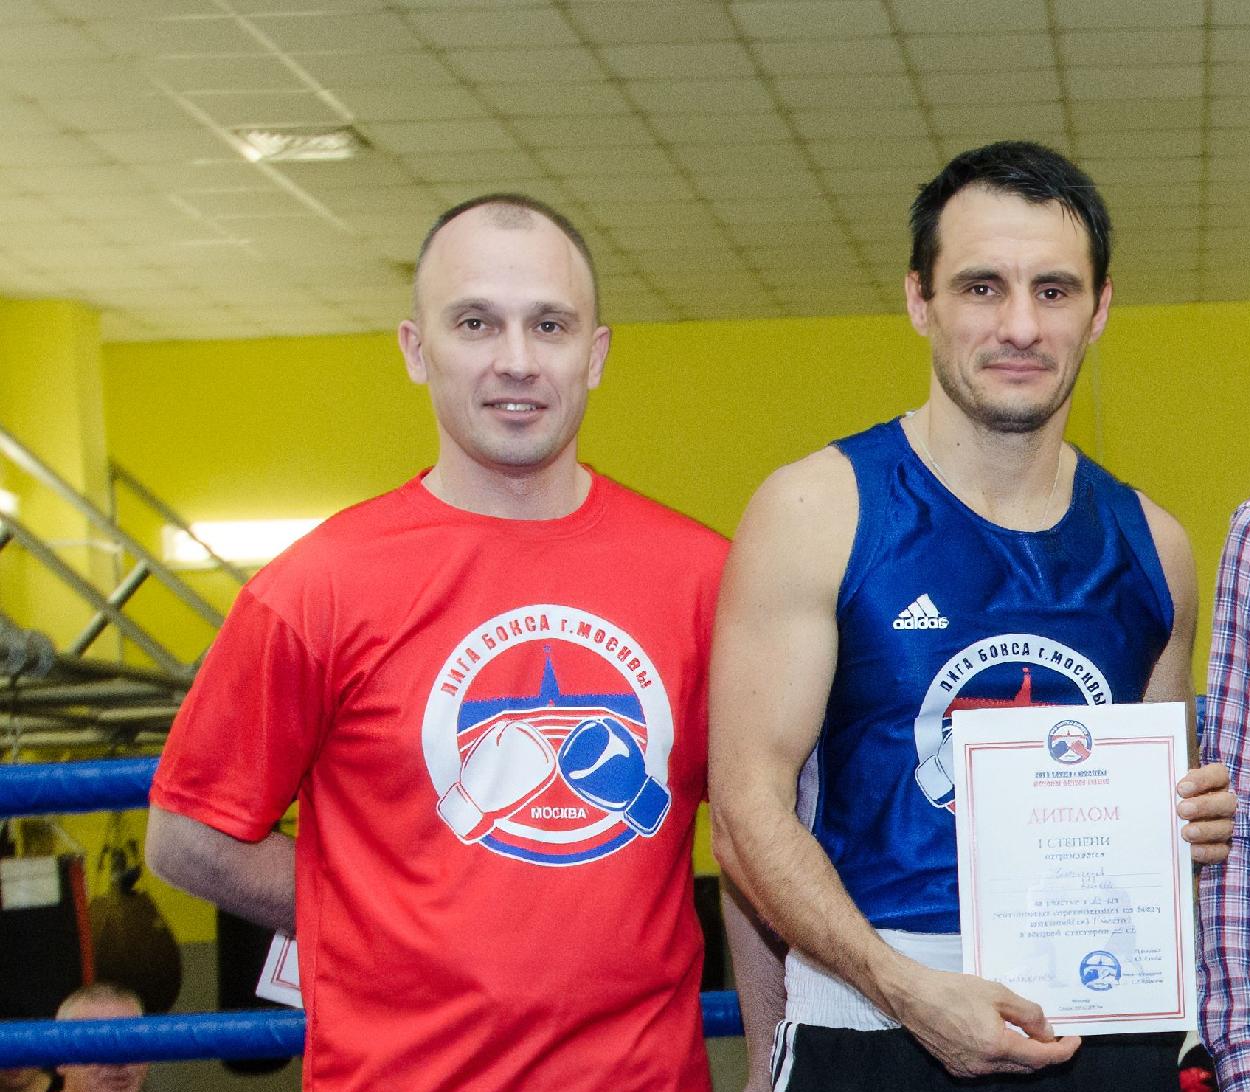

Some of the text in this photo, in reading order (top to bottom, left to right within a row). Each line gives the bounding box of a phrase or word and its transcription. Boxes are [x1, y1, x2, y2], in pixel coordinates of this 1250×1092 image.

[893, 616, 950, 630] adidas
[481, 614, 550, 652] БОКСА
[530, 806, 588, 820] МОСКВА
[1027, 804, 1121, 825] ДИПЛОМ
